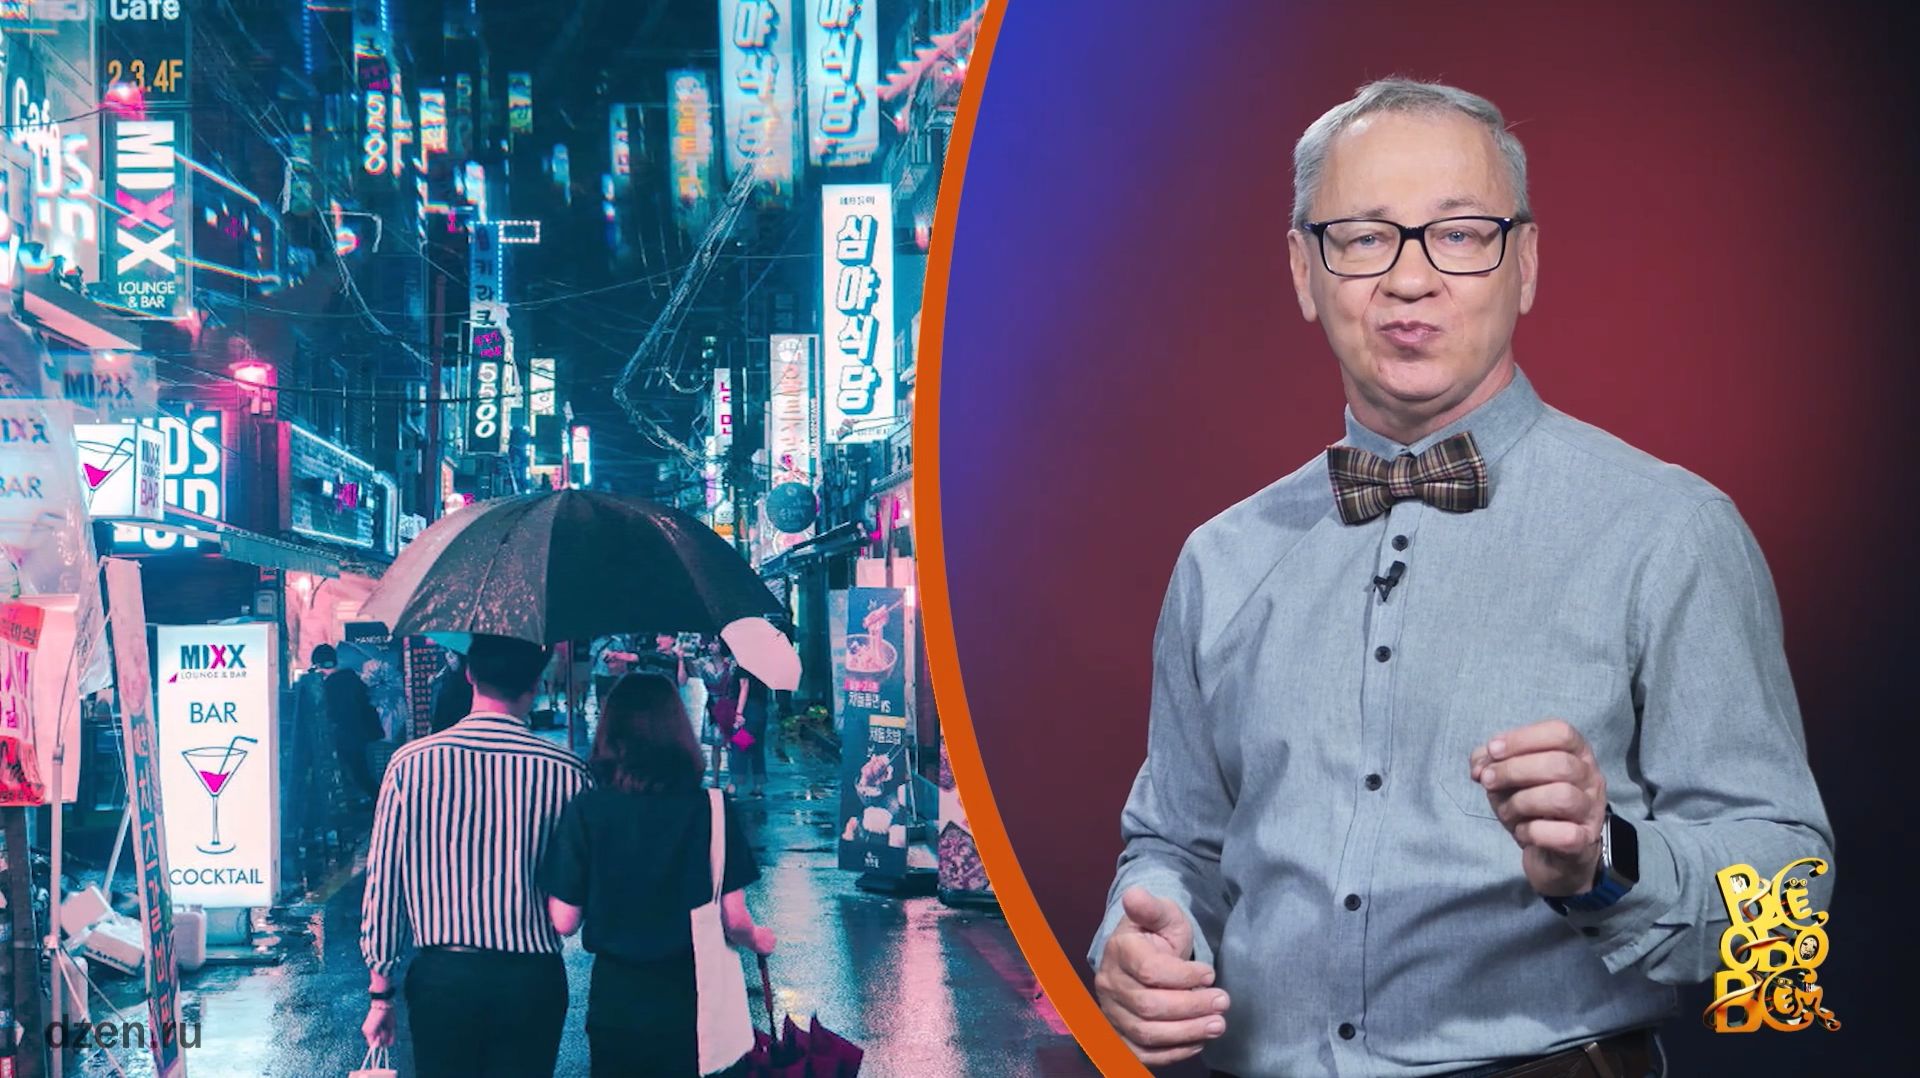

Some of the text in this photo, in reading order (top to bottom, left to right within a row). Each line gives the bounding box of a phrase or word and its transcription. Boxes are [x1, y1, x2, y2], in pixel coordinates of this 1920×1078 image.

[116, 121, 175, 275] MIXX
[117, 281, 176, 295] LOUNGE
[128, 296, 166, 309] & BAR
[836, 214, 882, 416] 심야식당
[474, 362, 499, 438] 5500
[180, 644, 247, 670] MIXX
[180, 671, 220, 680] LOUNGE
[229, 671, 248, 679] BAR
[189, 702, 238, 723] BAR
[168, 868, 265, 886] COCKTAIL
